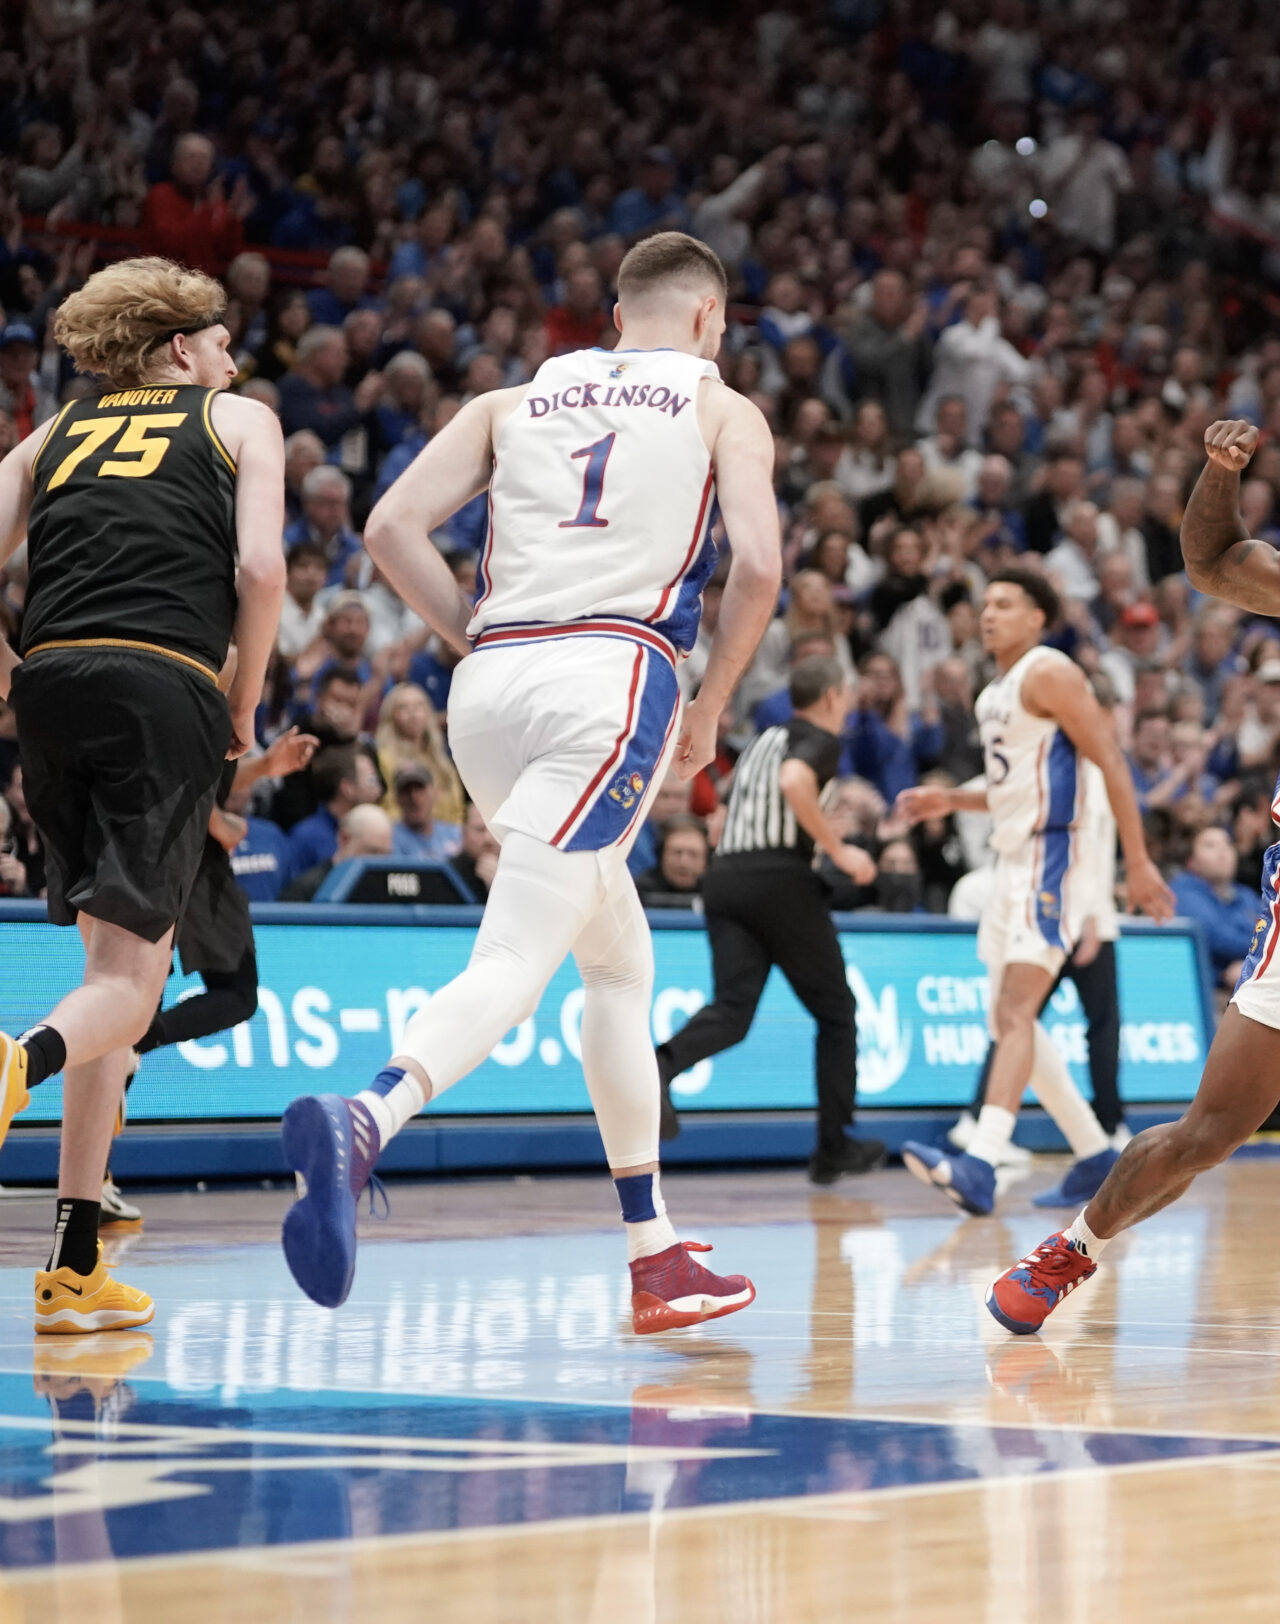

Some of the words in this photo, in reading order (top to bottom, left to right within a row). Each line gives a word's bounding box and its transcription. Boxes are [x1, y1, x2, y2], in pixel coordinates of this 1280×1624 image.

[97, 389, 178, 408] VANOVER
[527, 383, 691, 418] DICKINSON
[46, 413, 189, 492] 75
[558, 432, 616, 528] 1
[916, 976, 989, 1015] CENT
